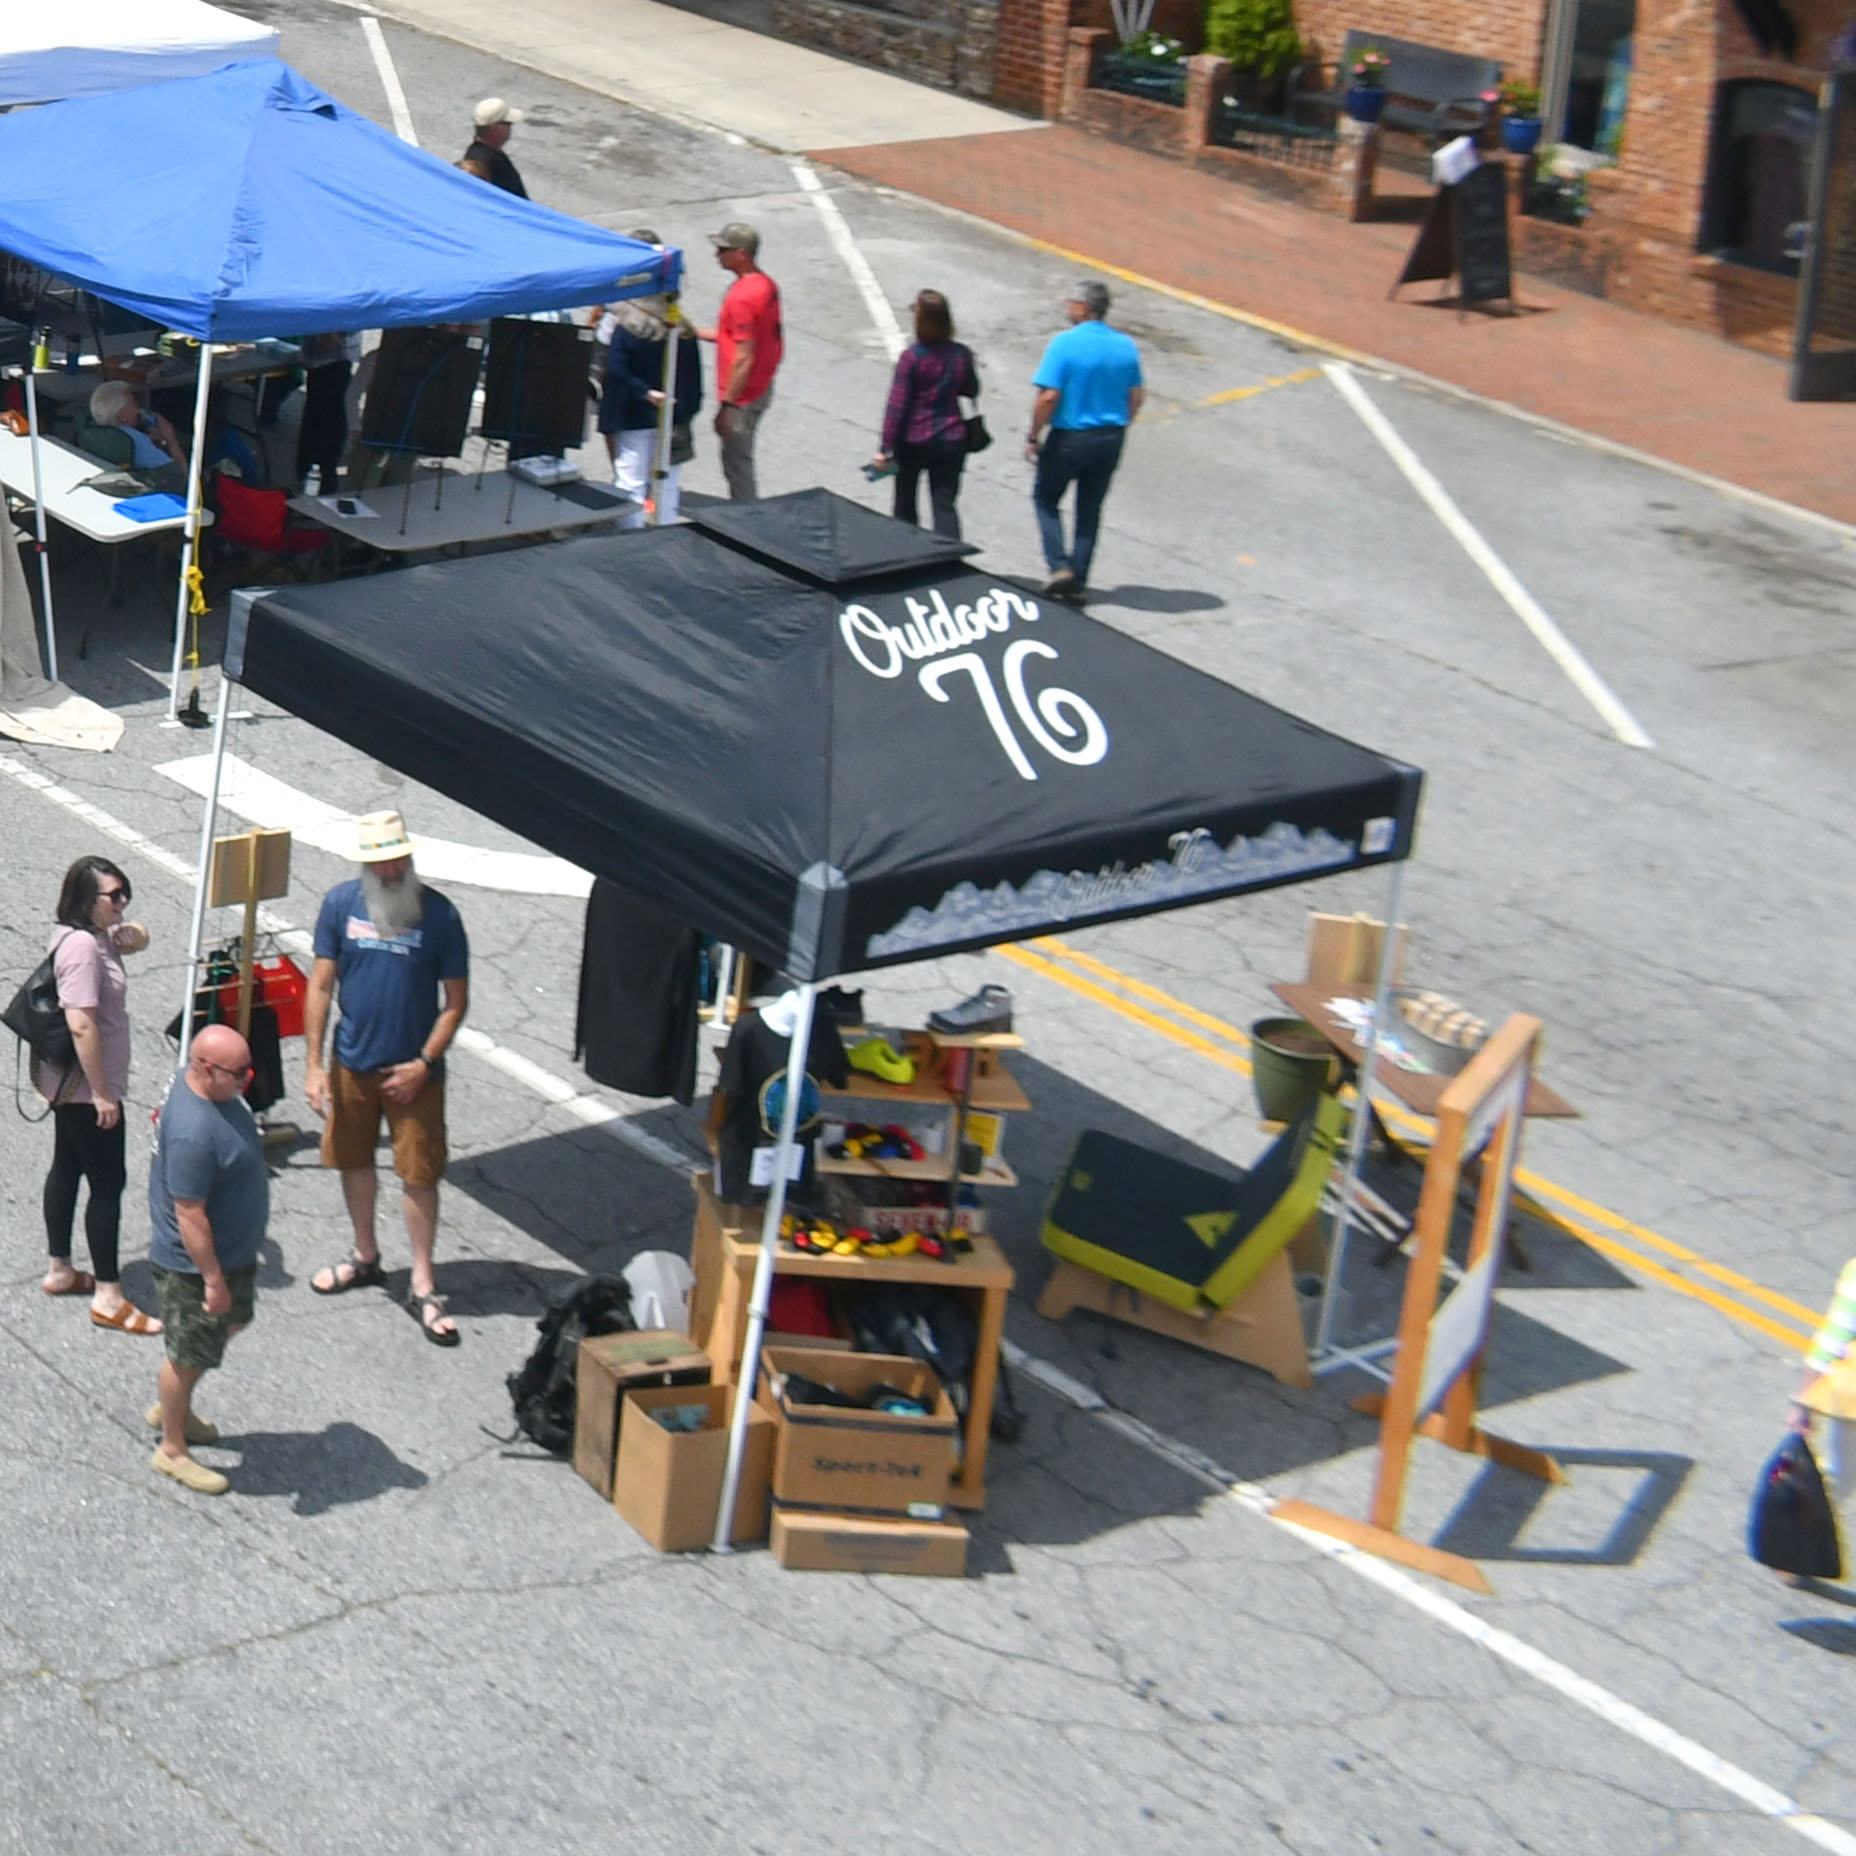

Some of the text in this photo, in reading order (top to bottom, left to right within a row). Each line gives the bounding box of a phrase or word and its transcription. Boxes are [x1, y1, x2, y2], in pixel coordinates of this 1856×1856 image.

[840, 588, 1040, 678] Outdoor
[918, 639, 1109, 781] 76
[1167, 827, 1212, 874] 76
